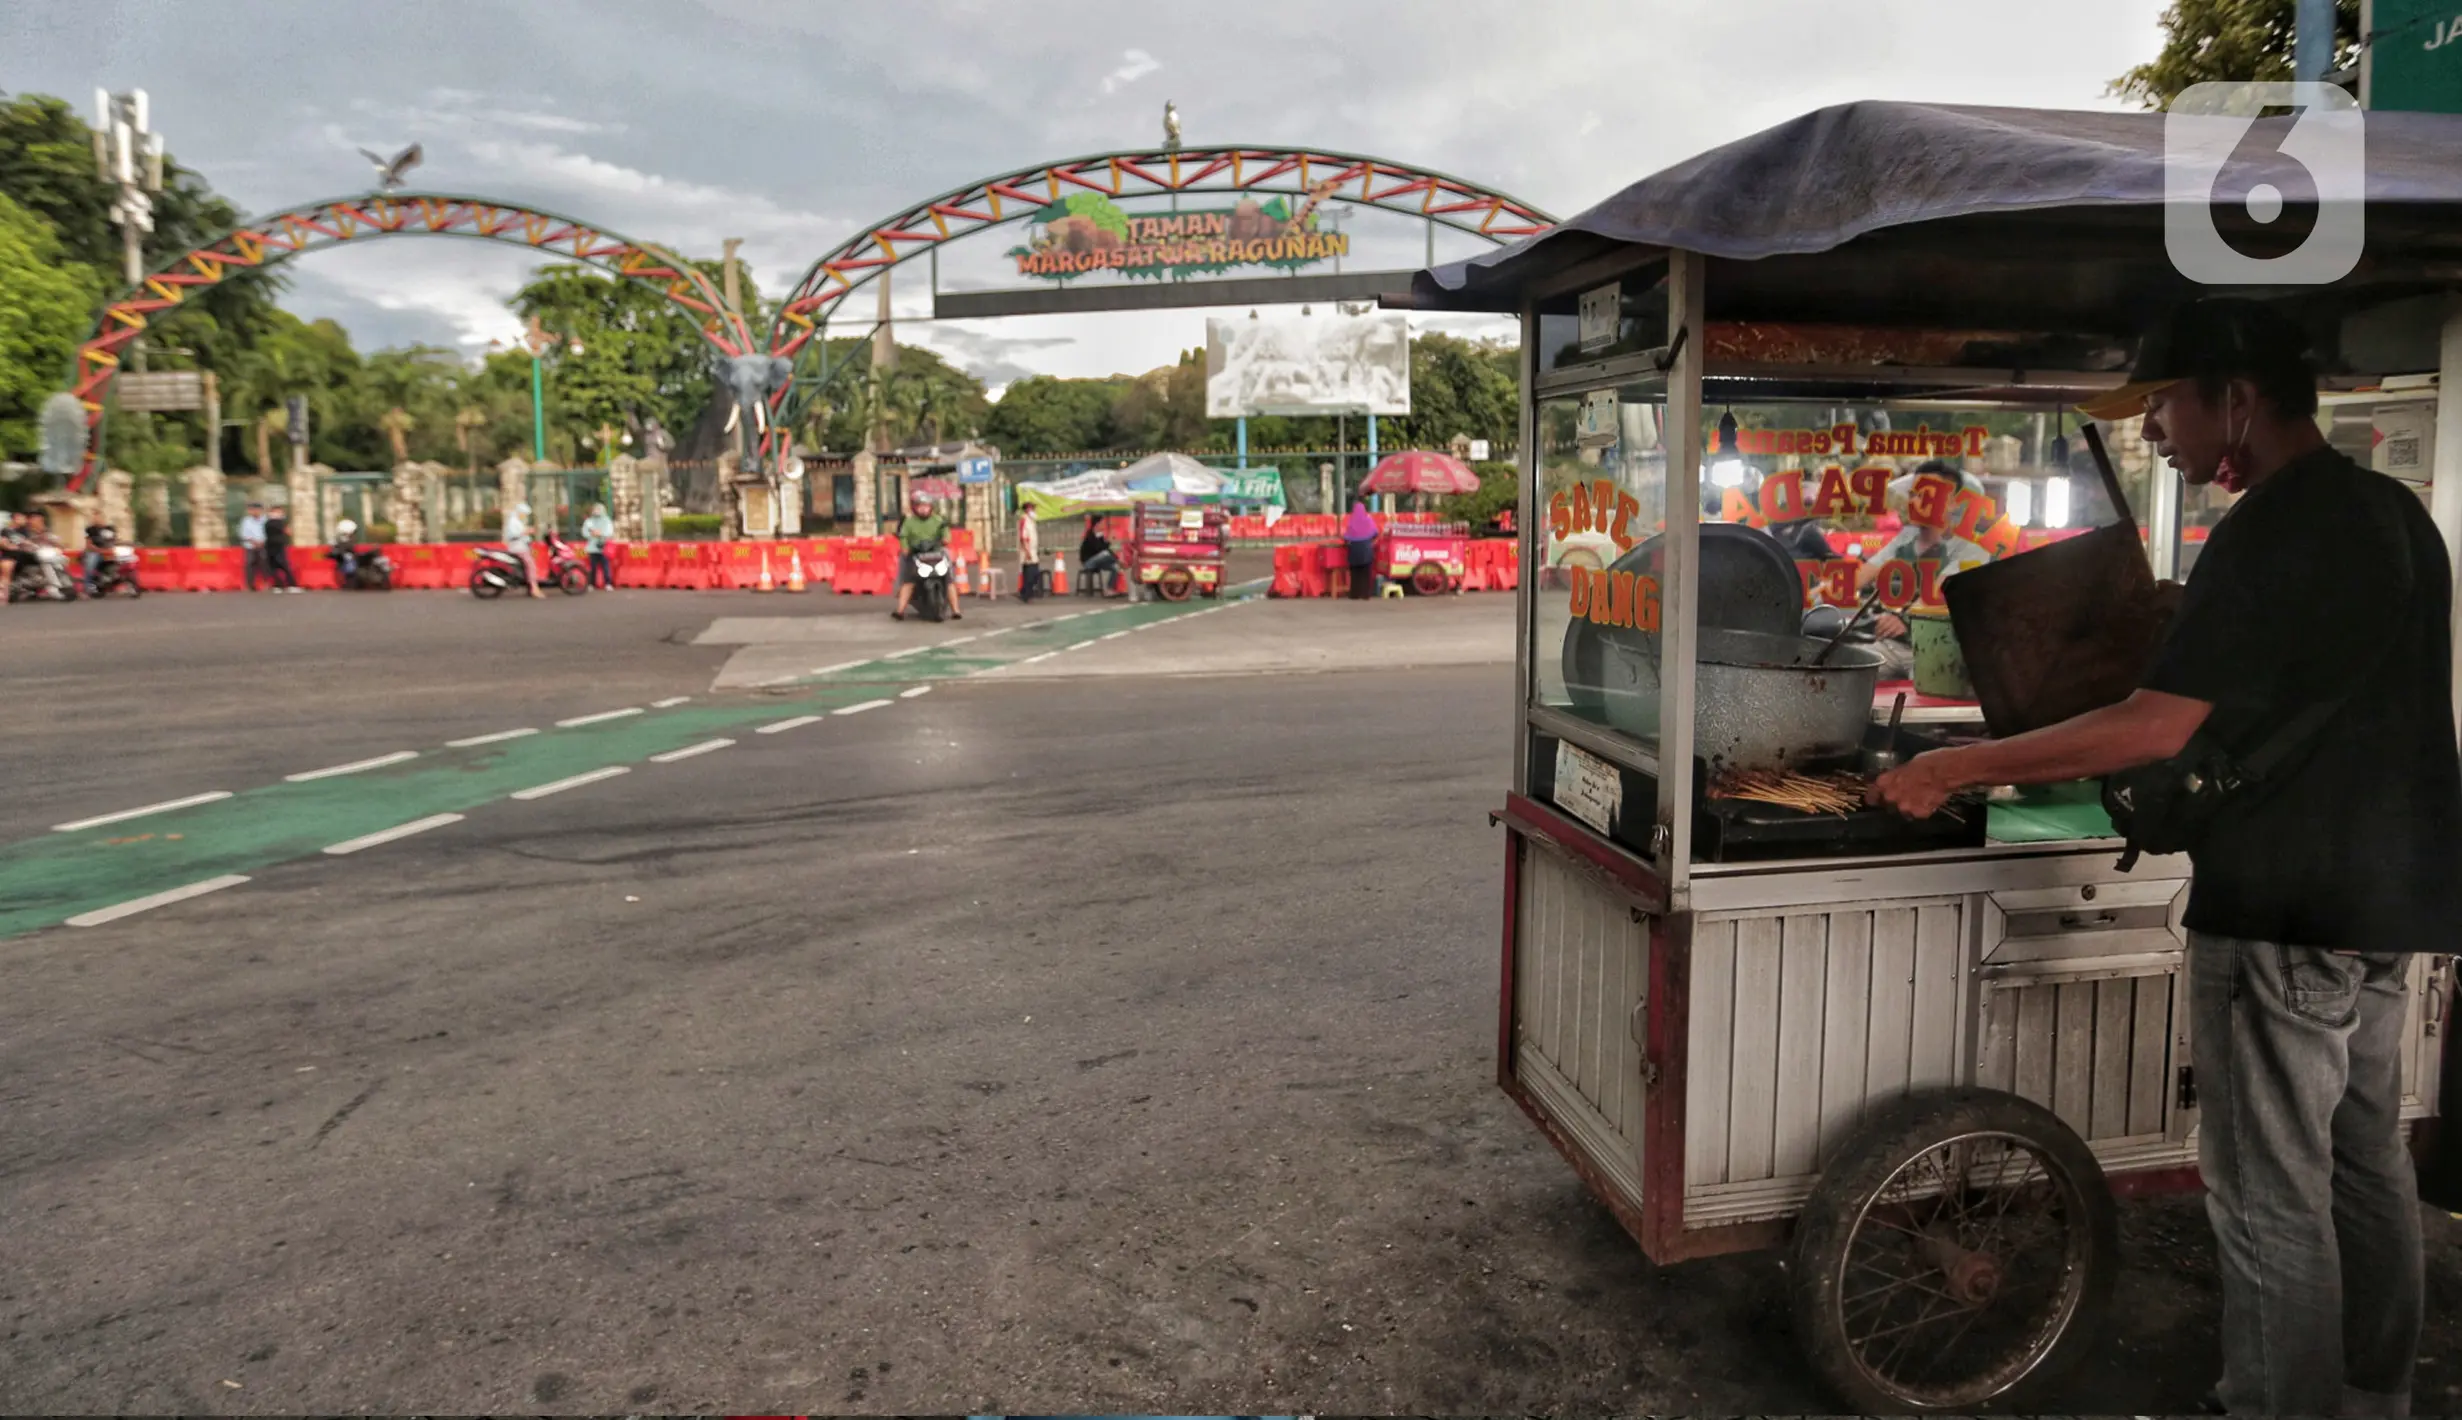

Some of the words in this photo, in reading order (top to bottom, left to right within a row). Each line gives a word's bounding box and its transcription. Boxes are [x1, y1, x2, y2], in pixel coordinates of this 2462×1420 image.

[1016, 242, 1207, 276] MARGASATWA
[1209, 233, 1350, 263] RAGUNAN
[1127, 213, 1226, 240] TAMAN
[1550, 479, 1640, 553] SATE
[1569, 564, 1660, 633] DANG
